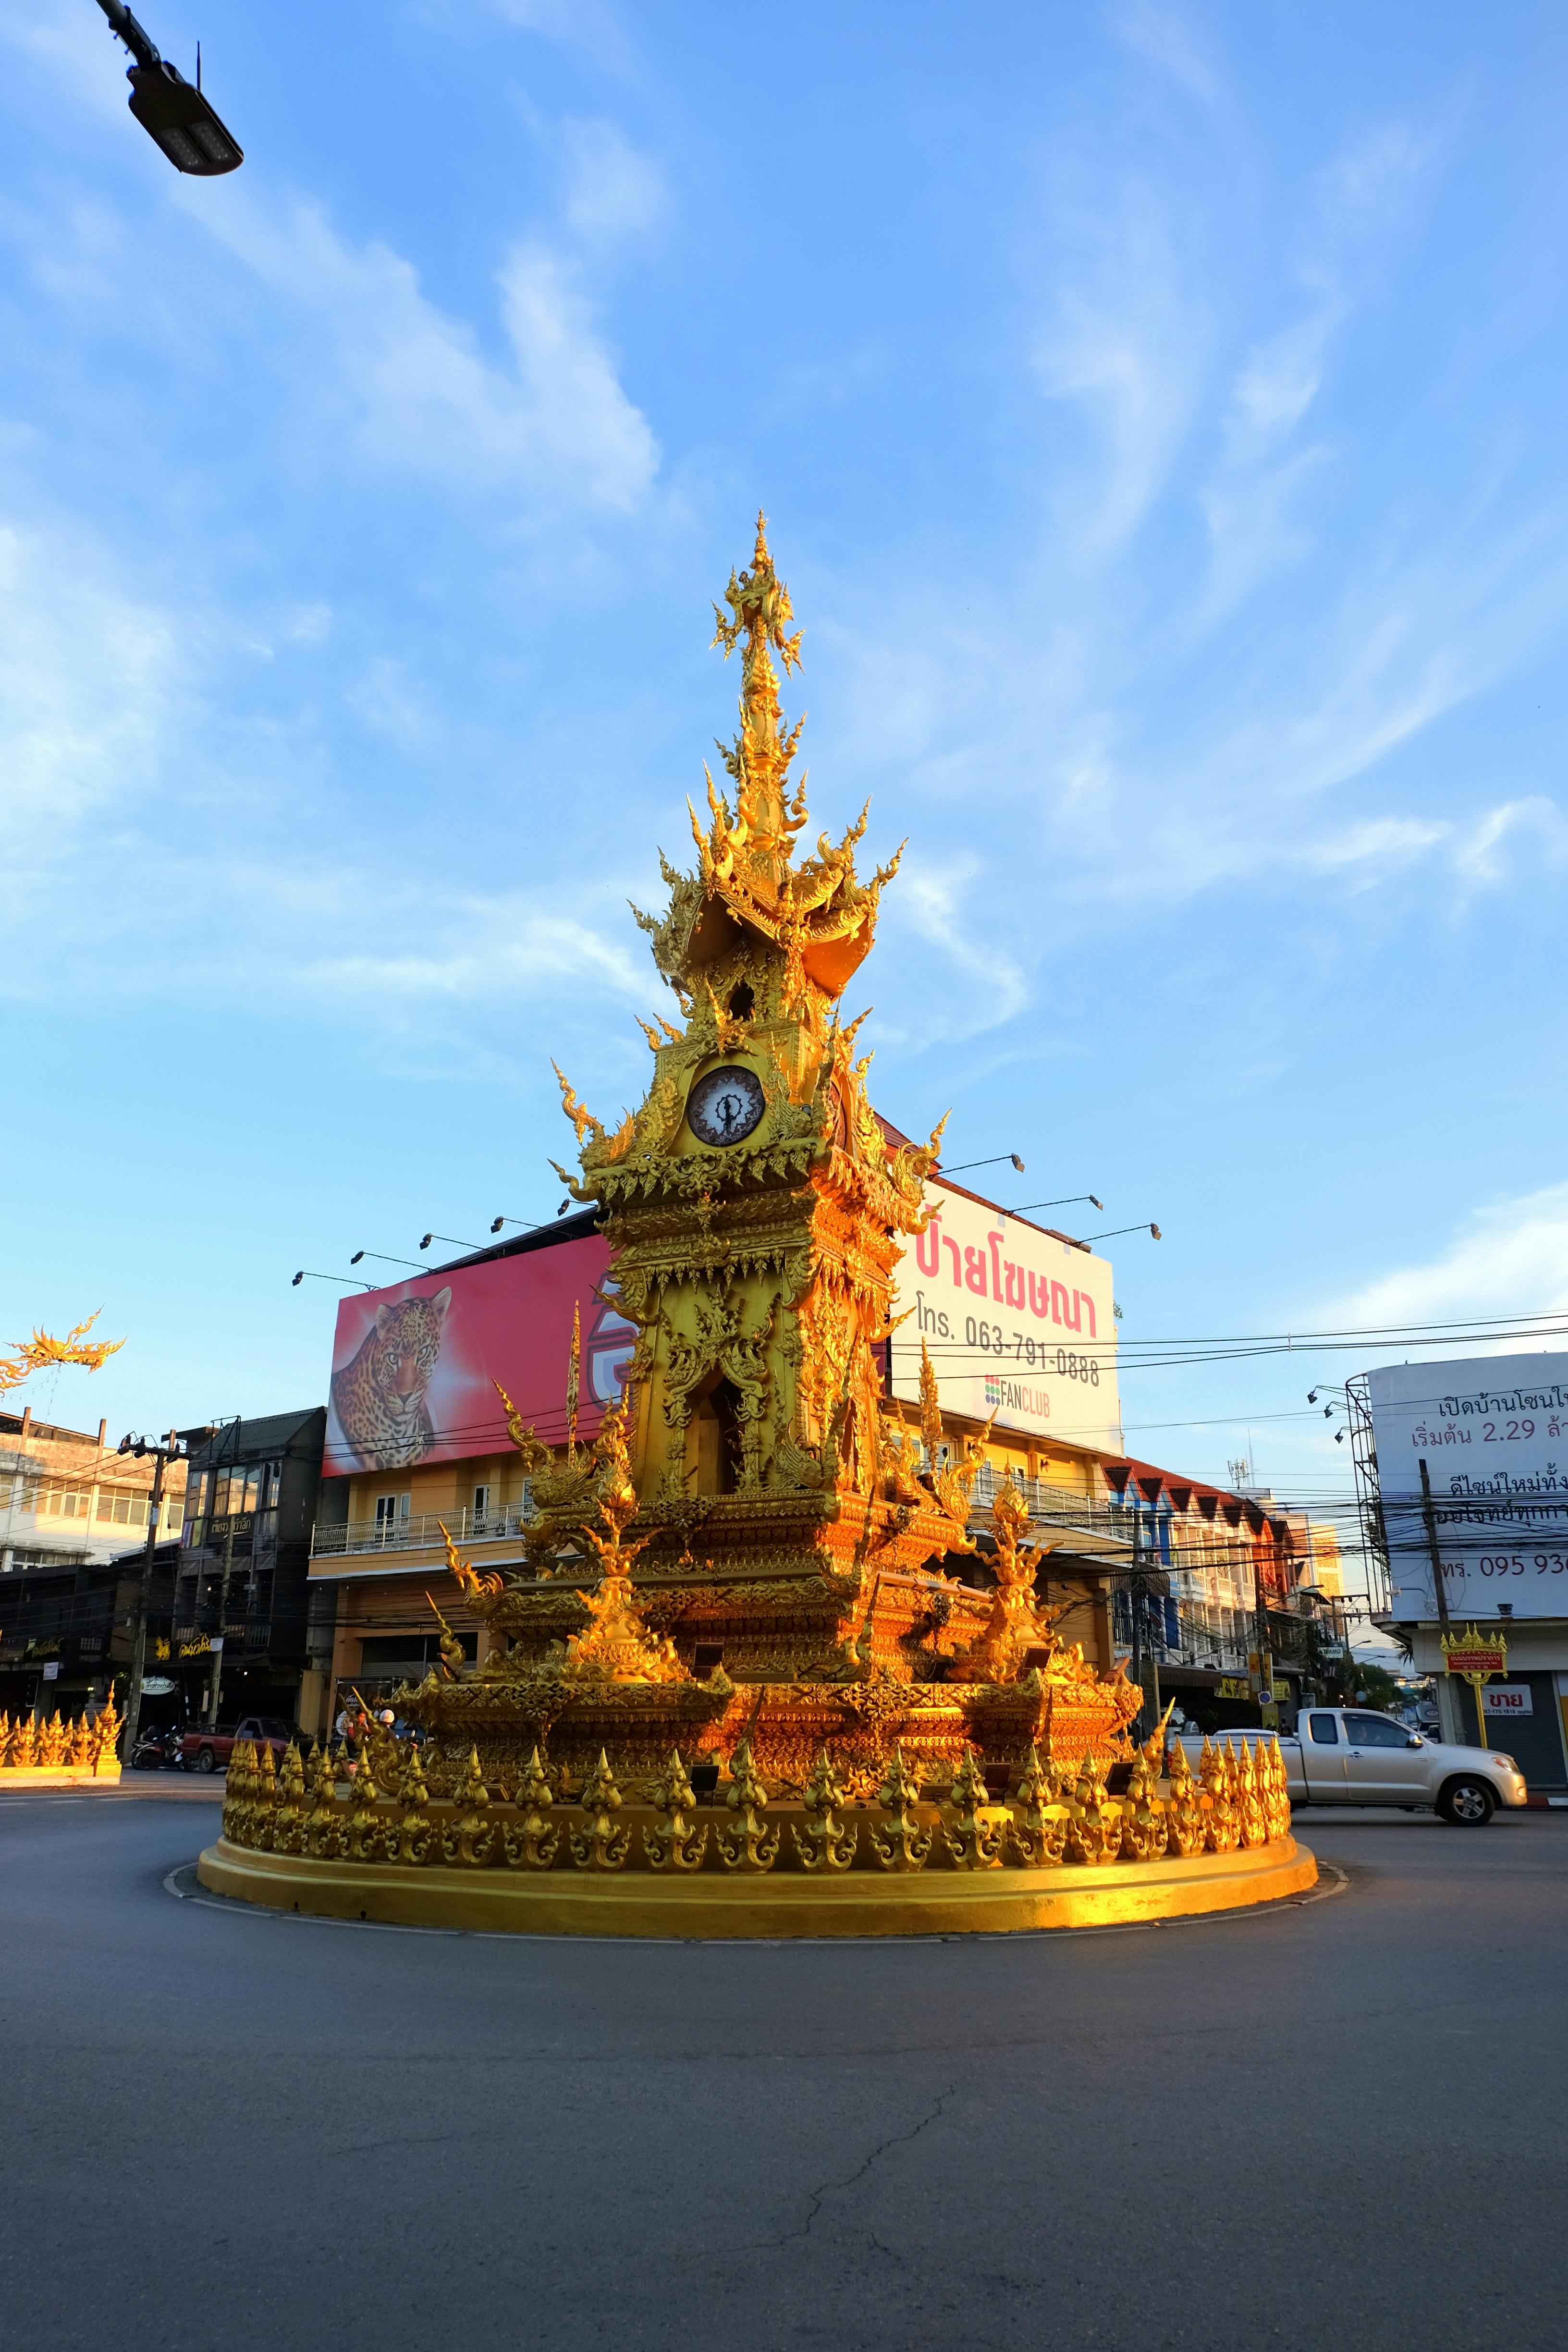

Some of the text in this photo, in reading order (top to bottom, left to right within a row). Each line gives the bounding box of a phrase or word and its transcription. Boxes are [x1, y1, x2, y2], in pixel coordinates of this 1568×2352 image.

[916, 1203, 1096, 1339] ป้ายโฆษณา
[916, 1290, 1099, 1387] โทร. 063-791-0888
[1000, 1380, 1050, 1418] FANCLUB
[1439, 1386, 1568, 1417] เปิดบ้านโซนใ
[1412, 1421, 1472, 1447] เริ่มต้น
[1482, 1419, 1535, 1442] 2.29
[1441, 1554, 1568, 1578] ทร. 095 93
[1489, 1693, 1523, 1707] ขาย
